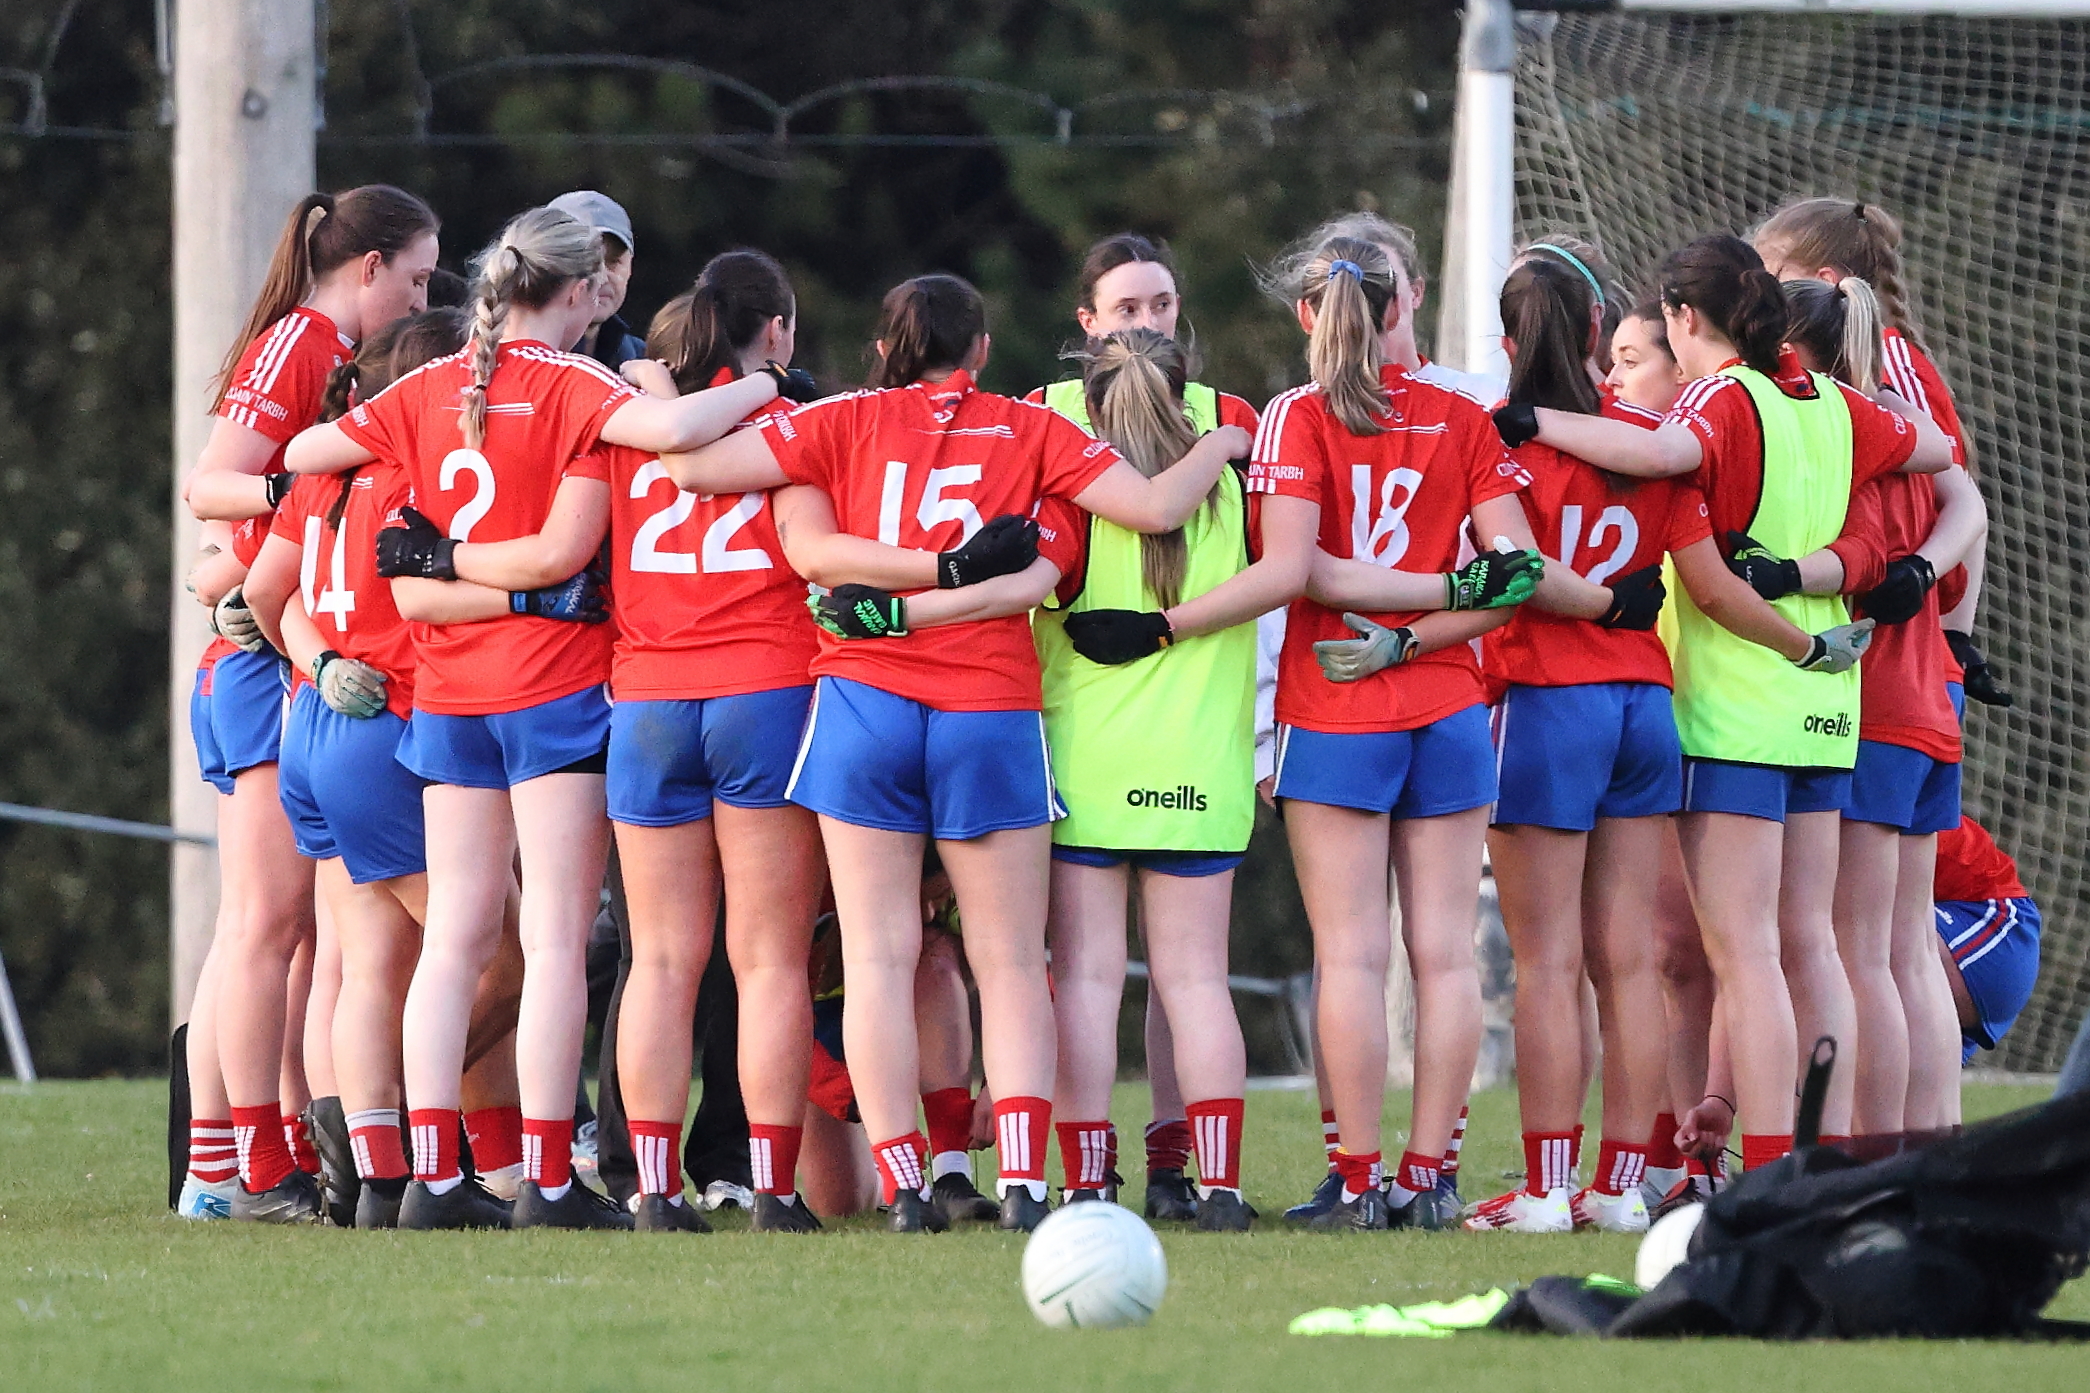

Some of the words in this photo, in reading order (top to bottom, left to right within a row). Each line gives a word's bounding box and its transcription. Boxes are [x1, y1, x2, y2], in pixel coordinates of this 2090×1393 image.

[255, 394, 289, 421] TARBH
[439, 448, 497, 543] 2
[629, 460, 774, 574] 22
[878, 460, 984, 553] 15
[1268, 466, 1304, 480] TARBH
[1352, 464, 1424, 568] 18
[299, 514, 356, 632] 14
[1560, 504, 1640, 586] 12
[862, 598, 888, 629] GAELIC
